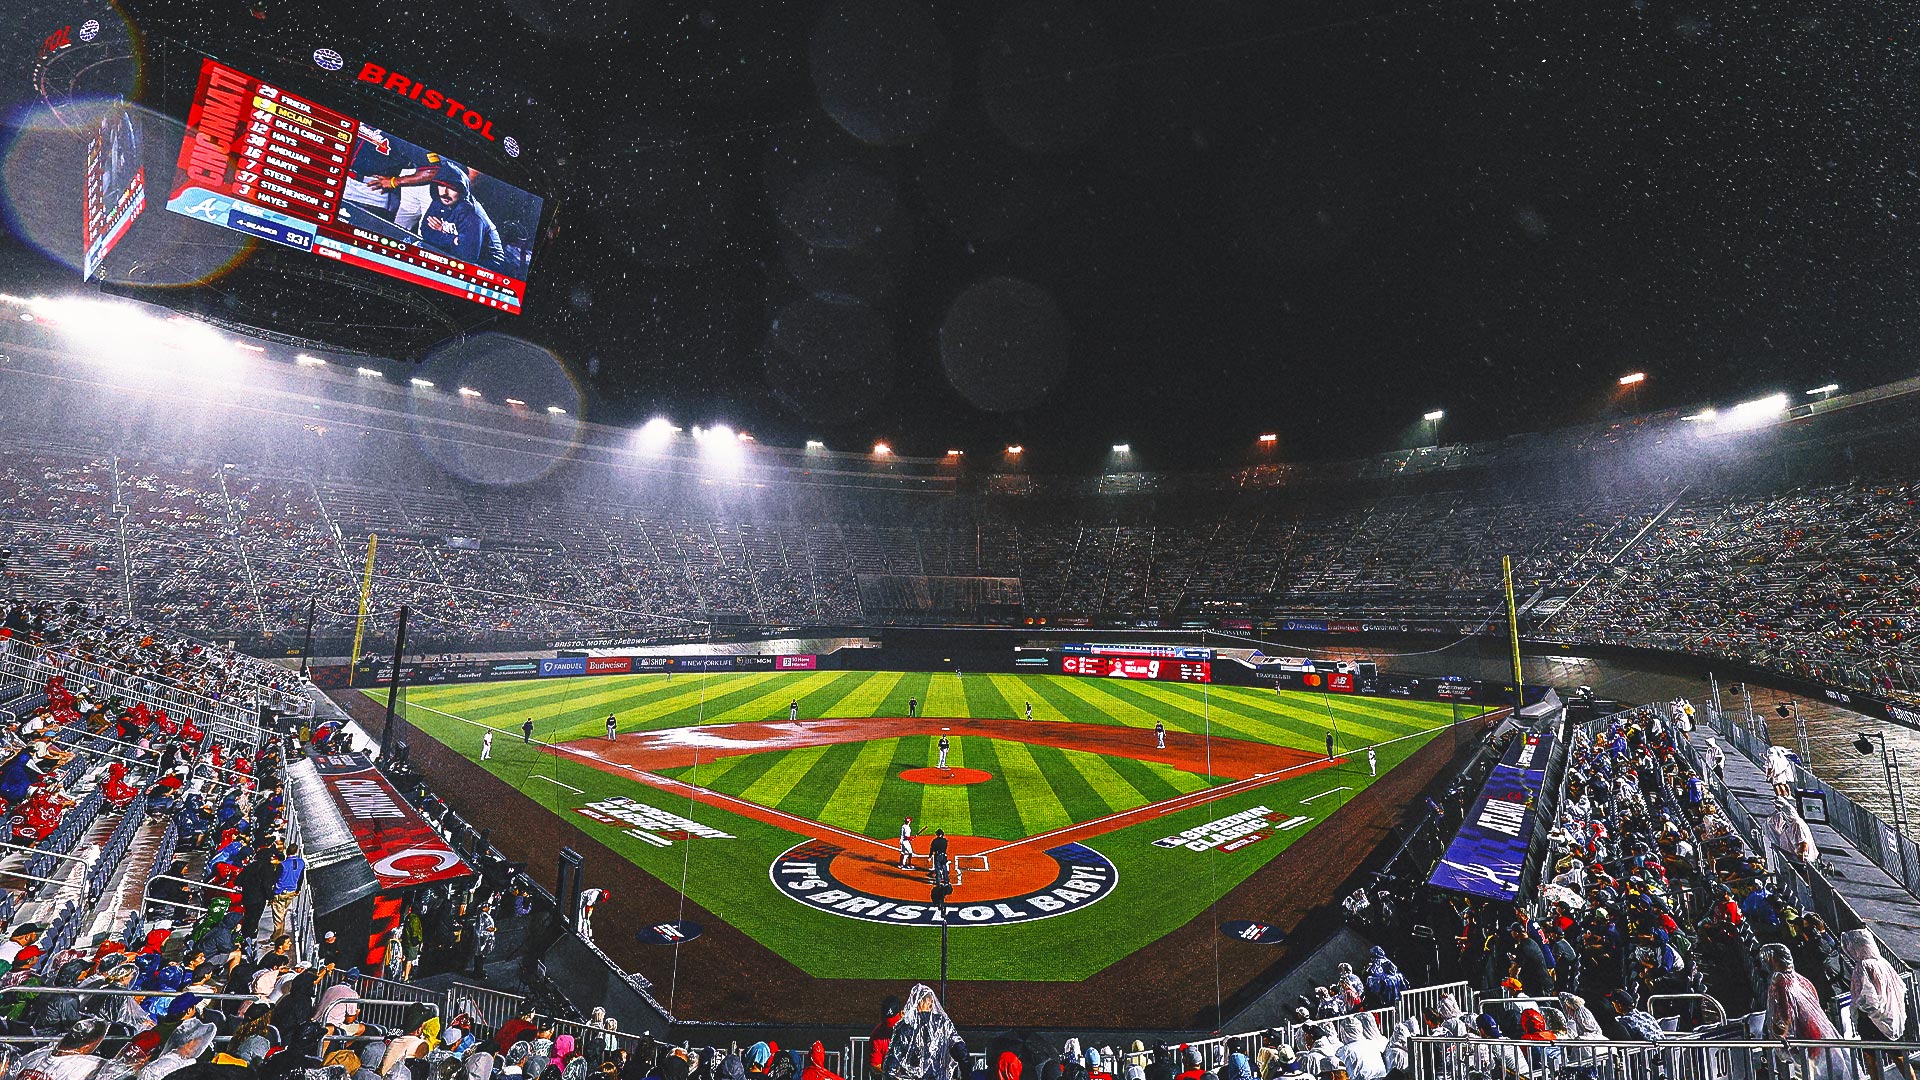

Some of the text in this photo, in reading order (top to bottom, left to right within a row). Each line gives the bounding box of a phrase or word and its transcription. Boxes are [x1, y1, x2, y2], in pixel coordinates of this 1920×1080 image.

[281, 95, 312, 114] FRIEDL
[357, 62, 496, 141] BRISTOL
[187, 66, 249, 188] CINCINNATI
[252, 111, 272, 123] 44
[275, 119, 288, 130] DE
[301, 127, 325, 144] CRUZ
[278, 107, 313, 127] MCLAIN
[250, 122, 269, 133] 12
[272, 131, 298, 147] HAYS
[243, 148, 262, 160] 16
[266, 156, 299, 173] MARTE
[268, 144, 311, 165] ANDUJAR
[246, 159, 257, 170] 7
[263, 168, 293, 184] STEER
[237, 170, 259, 183] 37
[260, 180, 319, 206] STEPHENSON
[238, 184, 251, 195] 3
[257, 192, 289, 209] HAYES
[354, 228, 379, 242] BALLS
[419, 250, 449, 265] STRIKES
[613, 637, 650, 645] SPEEDWAY
[589, 661, 628, 670] Budweiser
[650, 658, 668, 666] SHOP
[1148, 660, 1160, 678] 9
[1179, 805, 1274, 839] SPEEDWAY
[1185, 820, 1270, 852] CLASSIC
[782, 861, 829, 890] IT'S
[1036, 865, 1106, 913] BABY!
[813, 889, 1026, 921] BRISTOL
